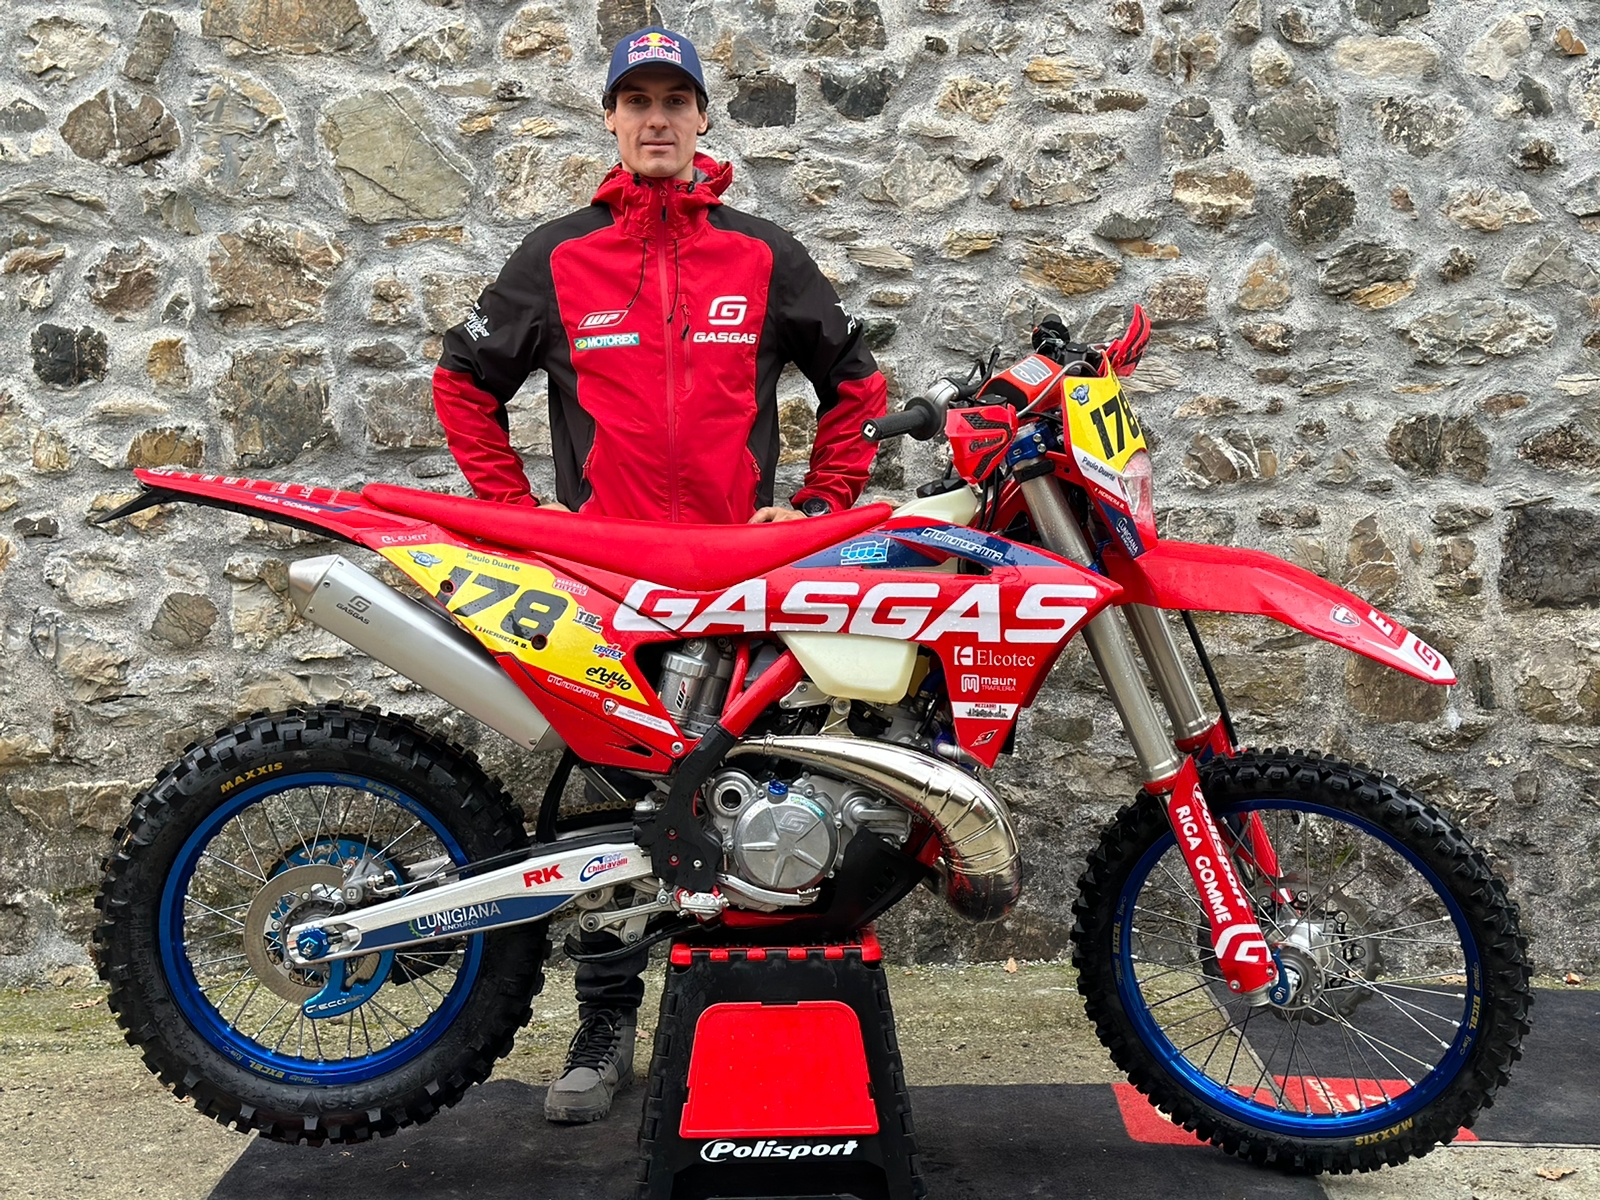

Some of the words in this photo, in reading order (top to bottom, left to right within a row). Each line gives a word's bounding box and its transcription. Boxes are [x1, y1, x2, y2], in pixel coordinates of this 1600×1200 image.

[628, 47, 654, 64] Red
[656, 48, 681, 64] Bull
[584, 313, 620, 326] WP
[587, 334, 637, 348] MOTOREX
[693, 332, 757, 344] GASGAS
[1082, 456, 1099, 471] Paulo
[1098, 465, 1116, 482] Duarte
[255, 494, 279, 504] RIGA
[282, 501, 321, 513] GOMME
[466, 552, 490, 564] Paulo
[491, 559, 520, 572] Duarte
[435, 566, 569, 641] 178
[613, 578, 1098, 644] GASGAS
[336, 603, 370, 624] GASGAS
[482, 628, 519, 645] HERRERA
[593, 644, 623, 658] VERTEX
[976, 649, 1036, 667] Elcotec
[585, 666, 632, 690] enduro
[605, 680, 617, 689] 3
[981, 677, 1017, 686] mauri
[220, 762, 283, 794] MAXXIS
[588, 858, 627, 874] Chiaravalli
[1176, 805, 1202, 851] RIGA
[1195, 855, 1232, 924] GOMME
[523, 863, 564, 888] RK
[416, 902, 501, 930] LUNIGIANA
[442, 920, 478, 931] ENDURO
[1355, 1117, 1413, 1146] MAXXIS
[700, 1139, 859, 1162] Polisport
